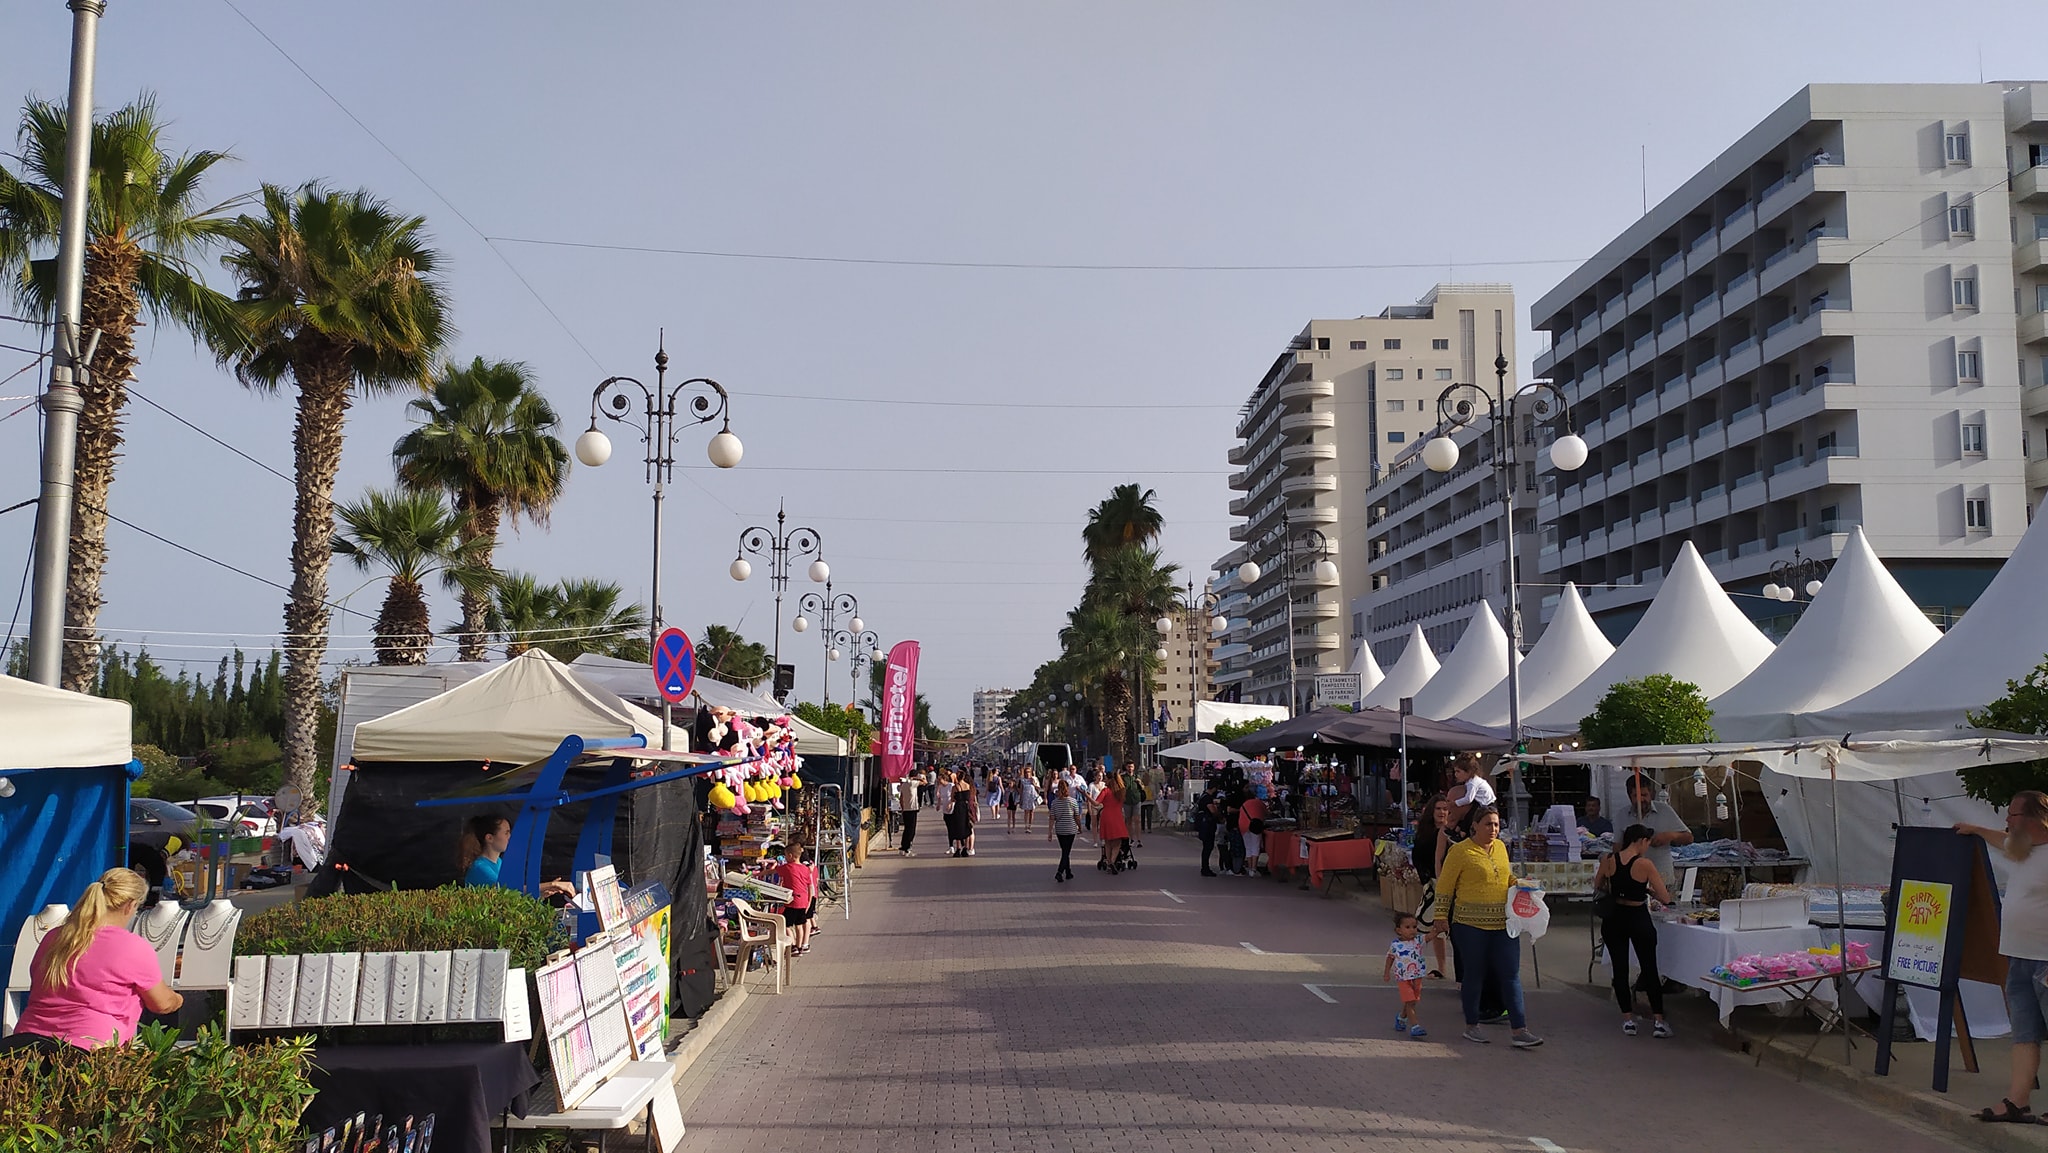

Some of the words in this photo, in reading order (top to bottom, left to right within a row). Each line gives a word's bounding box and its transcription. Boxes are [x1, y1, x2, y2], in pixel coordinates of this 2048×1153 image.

[884, 663, 909, 755] primetel
[1906, 892, 1942, 919] SPIRITUAL
[1908, 906, 1932, 925] ART
[1897, 956, 1911, 969] FREE
[1912, 959, 1938, 974] PICTURE
